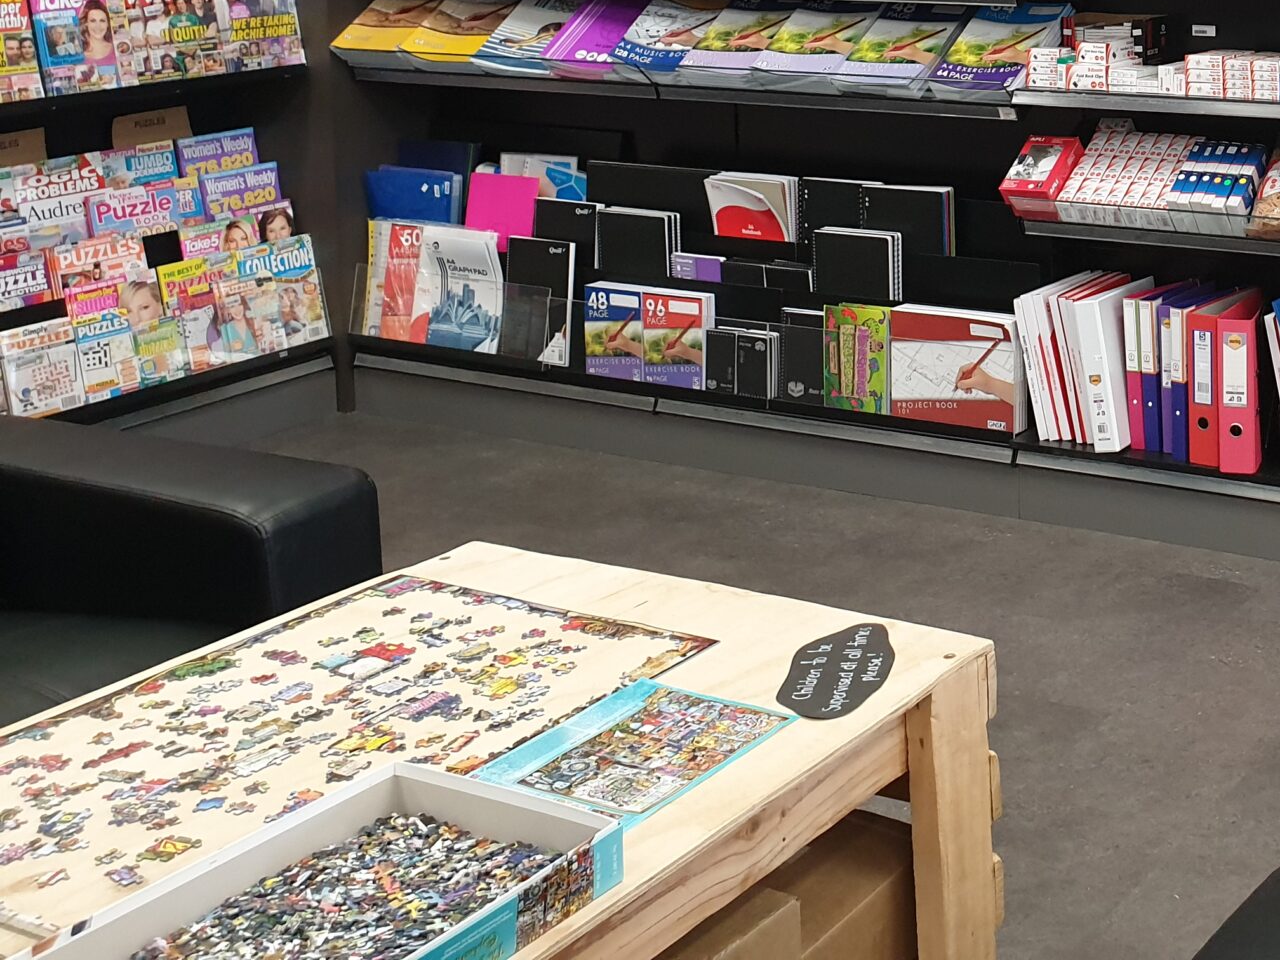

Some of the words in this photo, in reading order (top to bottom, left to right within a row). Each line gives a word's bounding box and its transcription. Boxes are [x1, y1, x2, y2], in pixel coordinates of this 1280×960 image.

[628, 49, 653, 64] PAGE
[635, 47, 666, 58] MUSIC
[950, 70, 974, 81] PAGE
[956, 64, 997, 74] EXERCISE
[998, 64, 1022, 73] BOOK
[129, 152, 174, 172] JUMBO
[205, 173, 244, 195] Women's
[244, 168, 277, 188] Weekly
[15, 175, 100, 204] PROBLEMS
[27, 201, 85, 224] Audre
[95, 191, 173, 224] Puzzle
[135, 212, 170, 227] BOOK
[59, 238, 141, 269] PUZZLES
[447, 263, 472, 275] GRAPH
[472, 266, 489, 277] PAD
[588, 291, 609, 310] 48
[645, 298, 666, 318] 96
[588, 309, 609, 318] PAGE
[646, 316, 668, 326] PAGE
[77, 319, 130, 339] PUZZLES
[587, 357, 619, 365] EXERCISE
[621, 359, 643, 367] BOOK
[645, 365, 678, 373] EXERCISE
[679, 365, 701, 374] BOOK
[897, 400, 933, 410] PROJECT
[935, 401, 959, 410] BOOK
[846, 626, 873, 647] times
[806, 643, 833, 653] be
[842, 648, 863, 659] all
[799, 656, 828, 666] to
[840, 661, 858, 670] at
[860, 652, 884, 681] please!
[791, 668, 823, 700] Children
[821, 671, 854, 712] Supervised
